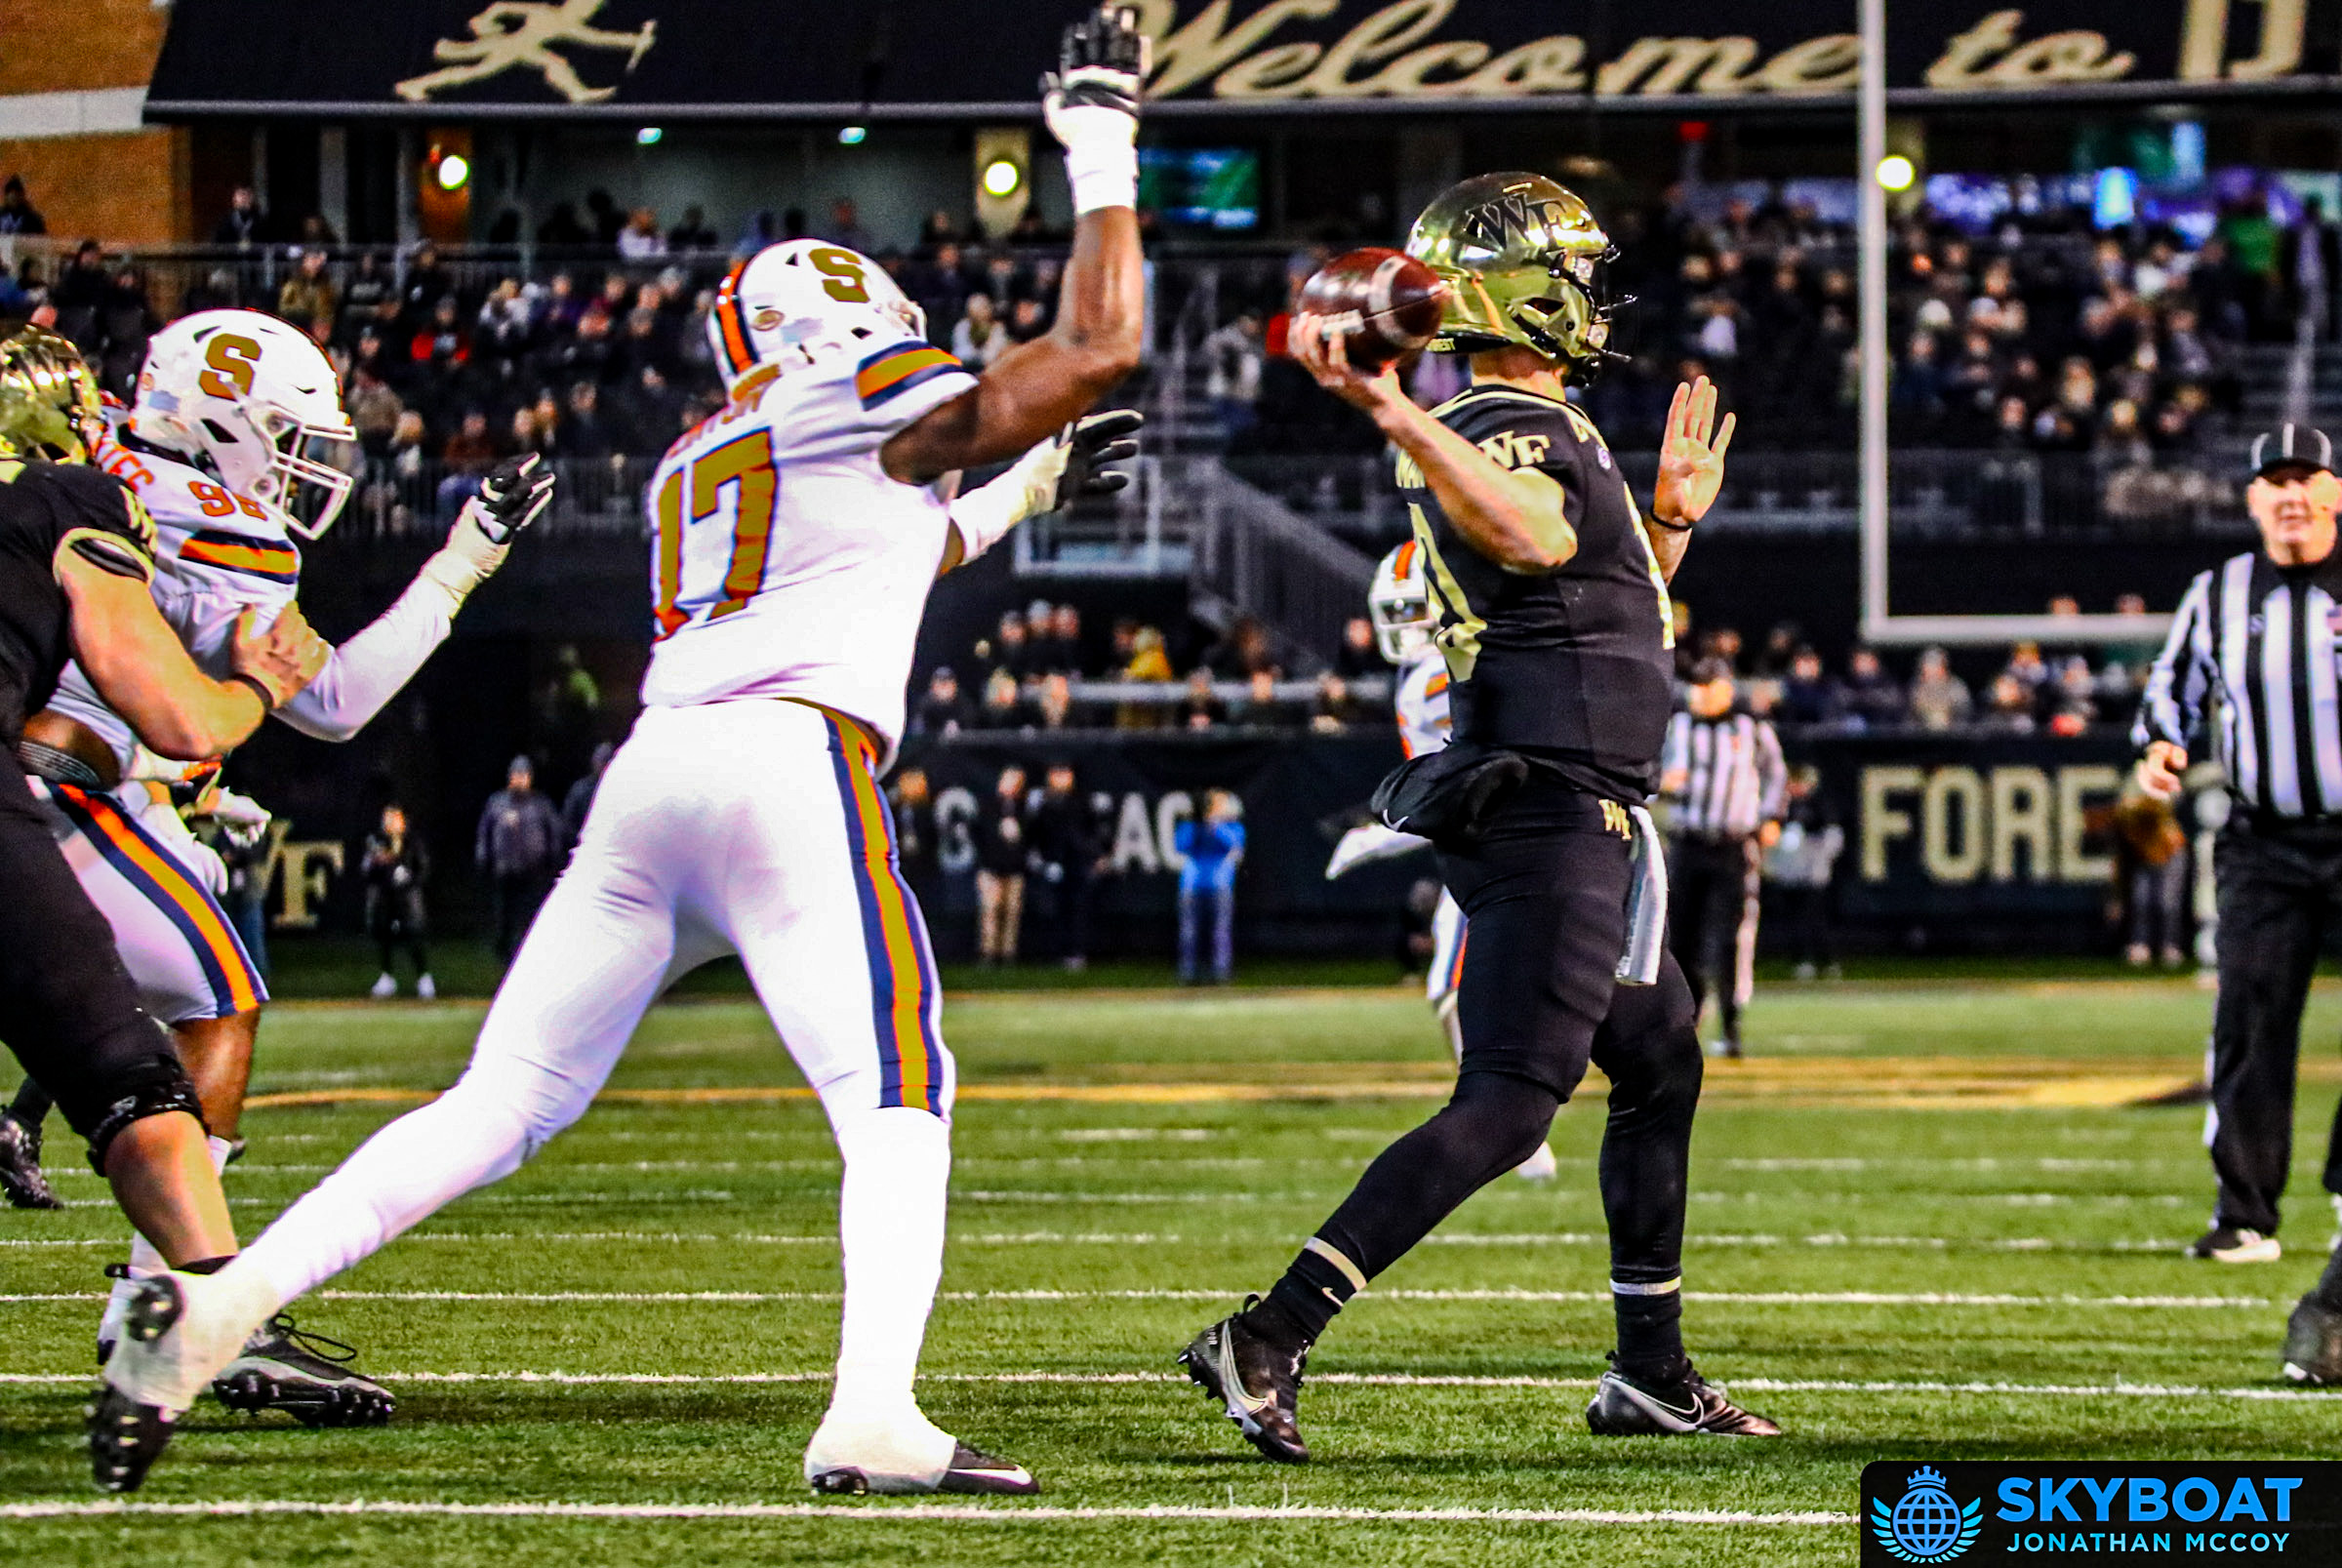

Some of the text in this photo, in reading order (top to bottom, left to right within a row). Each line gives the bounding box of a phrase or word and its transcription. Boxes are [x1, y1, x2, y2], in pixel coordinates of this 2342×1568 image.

[1140, 0, 1861, 100] Welcome
[1925, 9, 2137, 88] to
[1466, 192, 1567, 253] WF
[808, 248, 870, 303] S
[199, 333, 262, 401] S
[651, 425, 778, 643] 17
[1860, 763, 2147, 883] FORE
